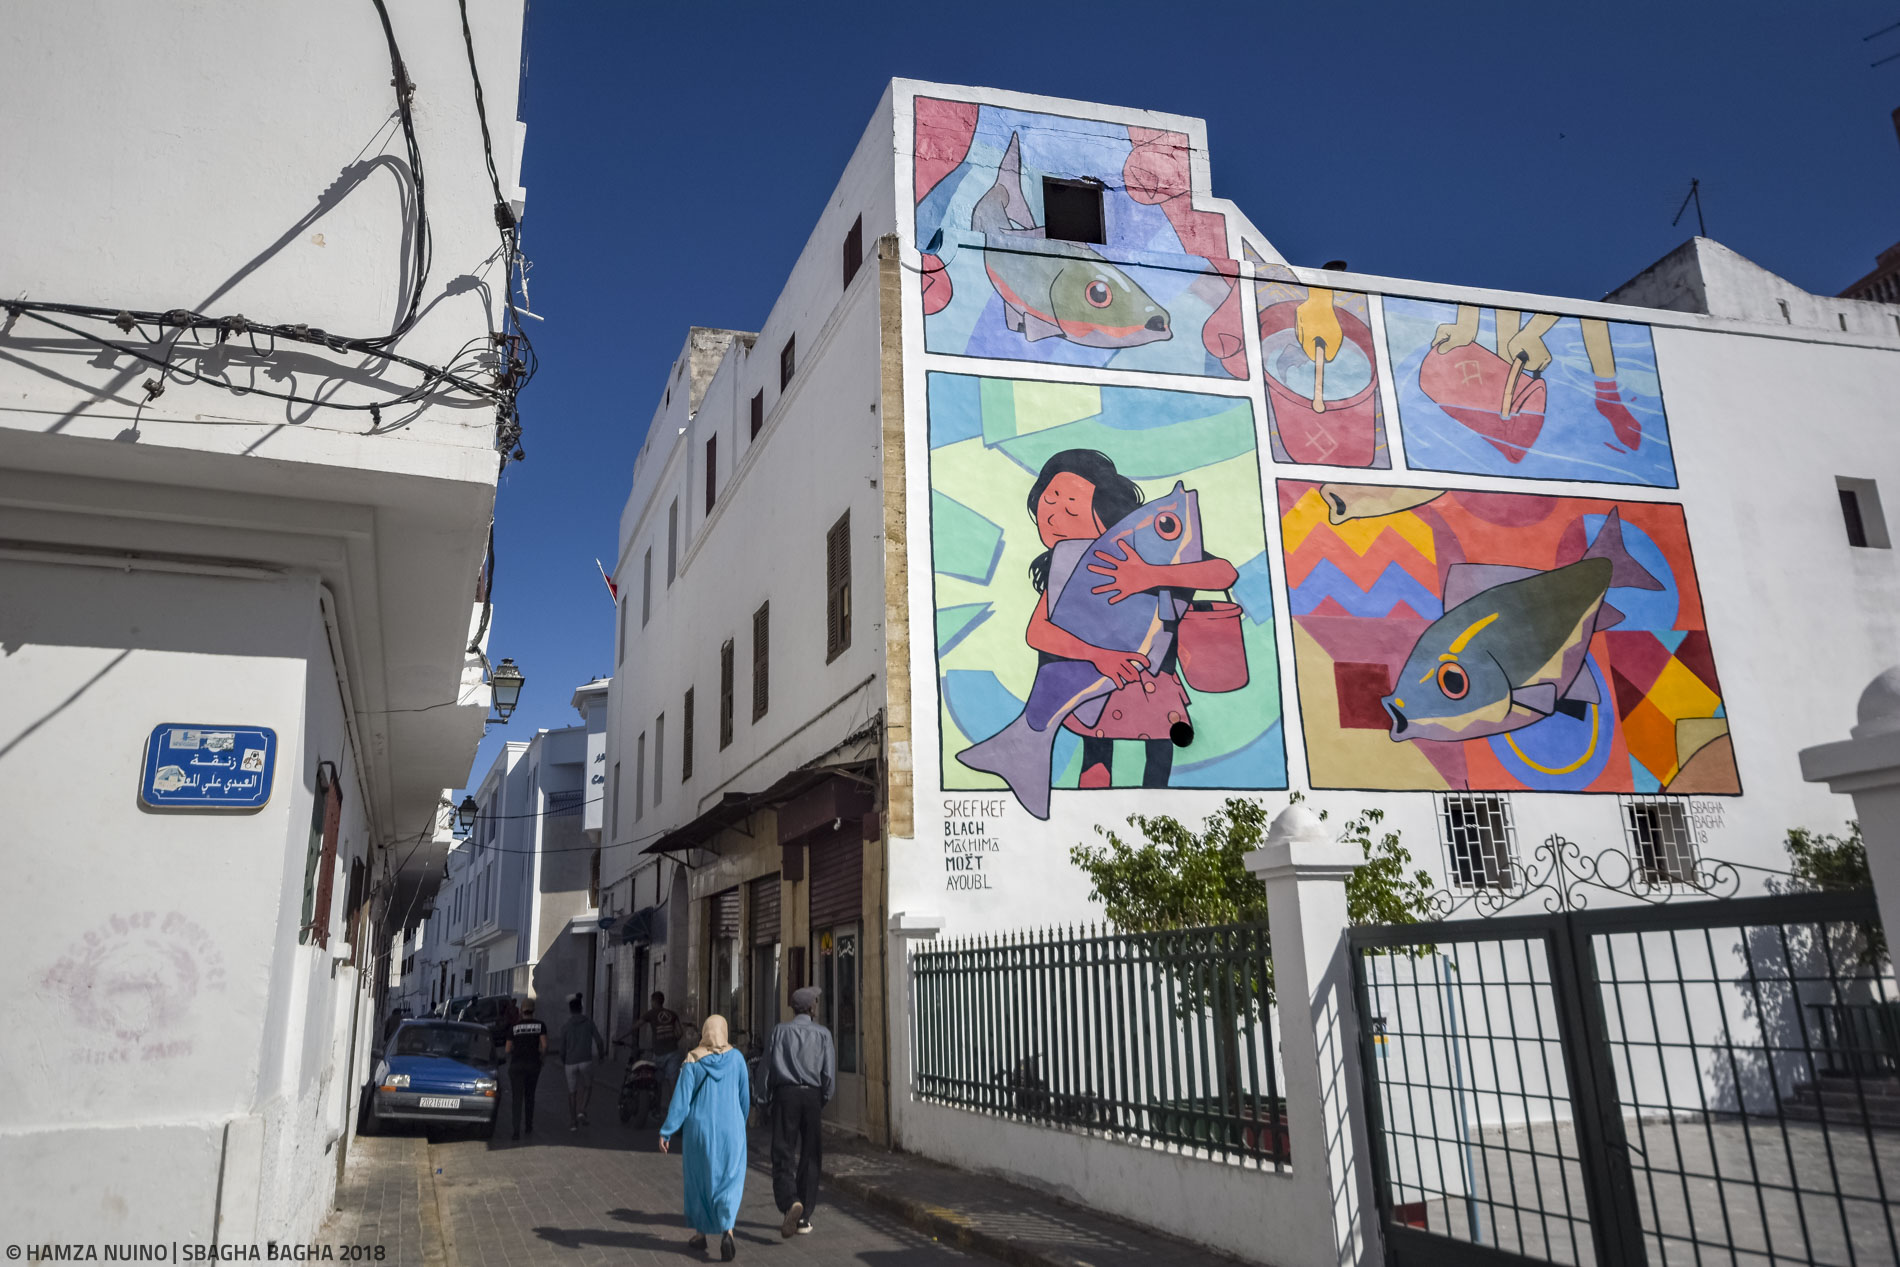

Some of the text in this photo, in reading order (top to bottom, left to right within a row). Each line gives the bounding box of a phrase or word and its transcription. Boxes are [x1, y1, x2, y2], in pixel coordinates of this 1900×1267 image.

[189, 753, 237, 770] زنقة
[943, 799, 1006, 818] SKEFKEF
[1691, 800, 1725, 814] SBAGHA
[944, 820, 985, 836] BLACH
[1694, 815, 1725, 829] BAGHA
